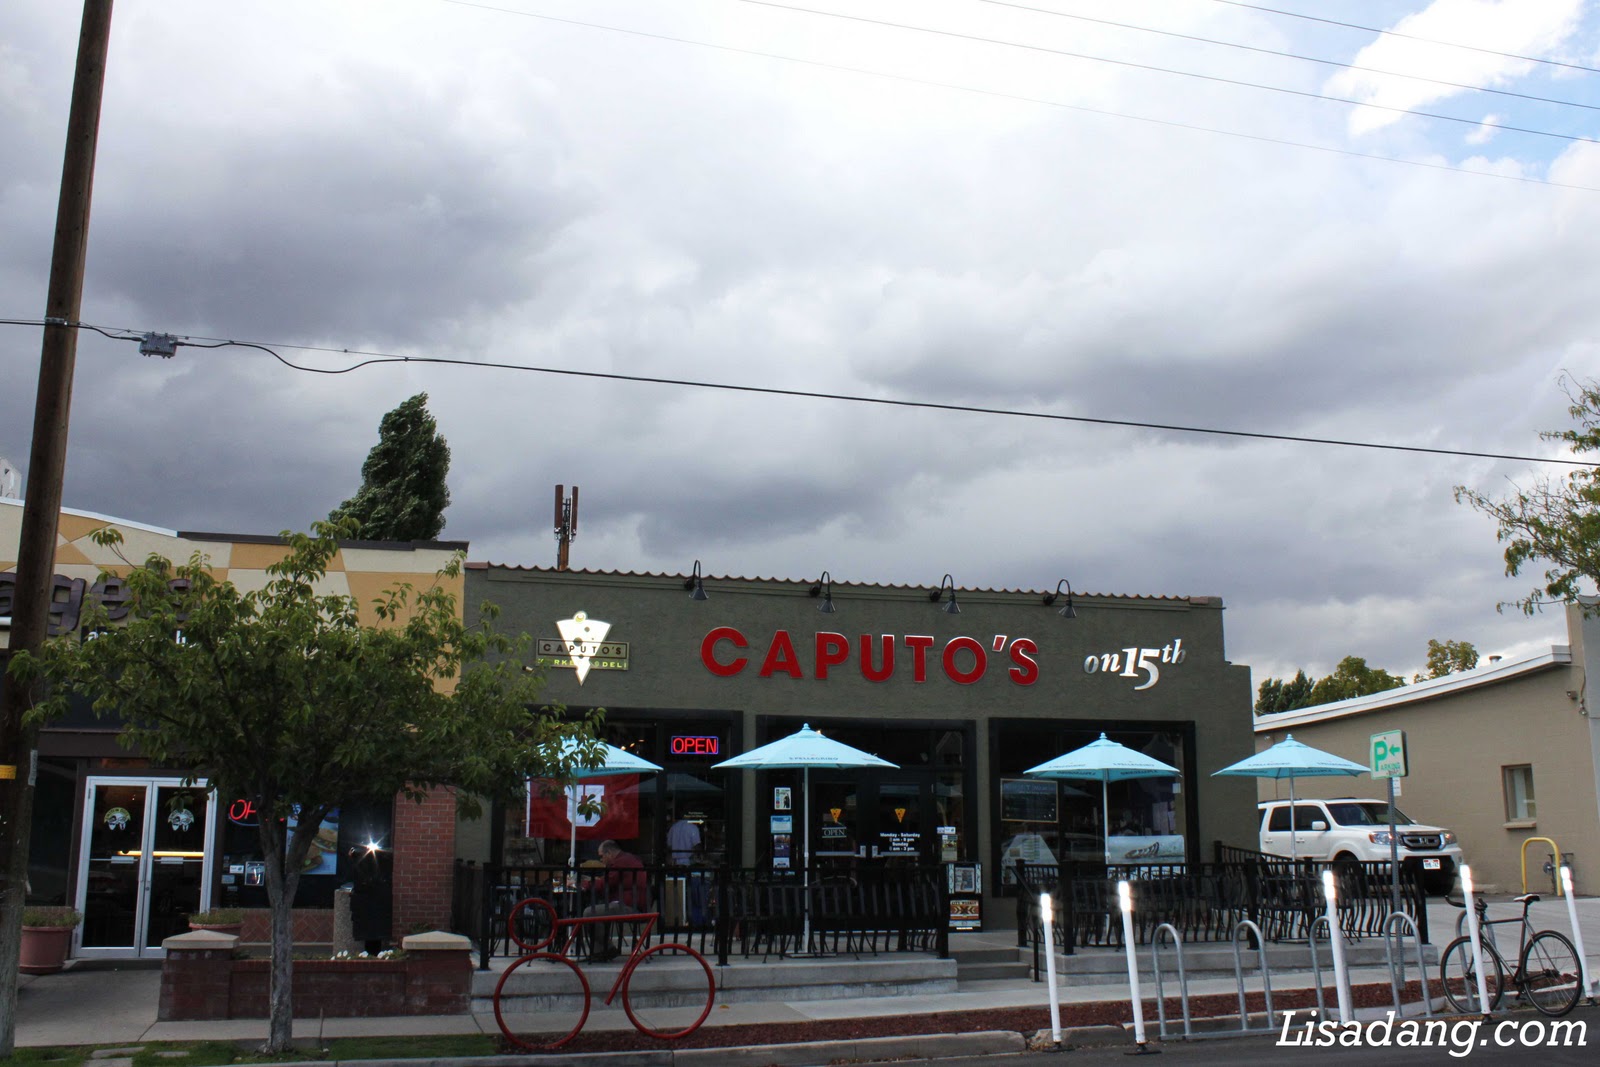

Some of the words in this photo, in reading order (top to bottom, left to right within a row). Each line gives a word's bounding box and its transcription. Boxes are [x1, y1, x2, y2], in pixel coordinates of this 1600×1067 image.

[543, 643, 622, 655] CAPUTO'S
[701, 626, 1039, 686] CAPUTO'S
[672, 737, 717, 753] OPEN
[564, 784, 605, 827] U
